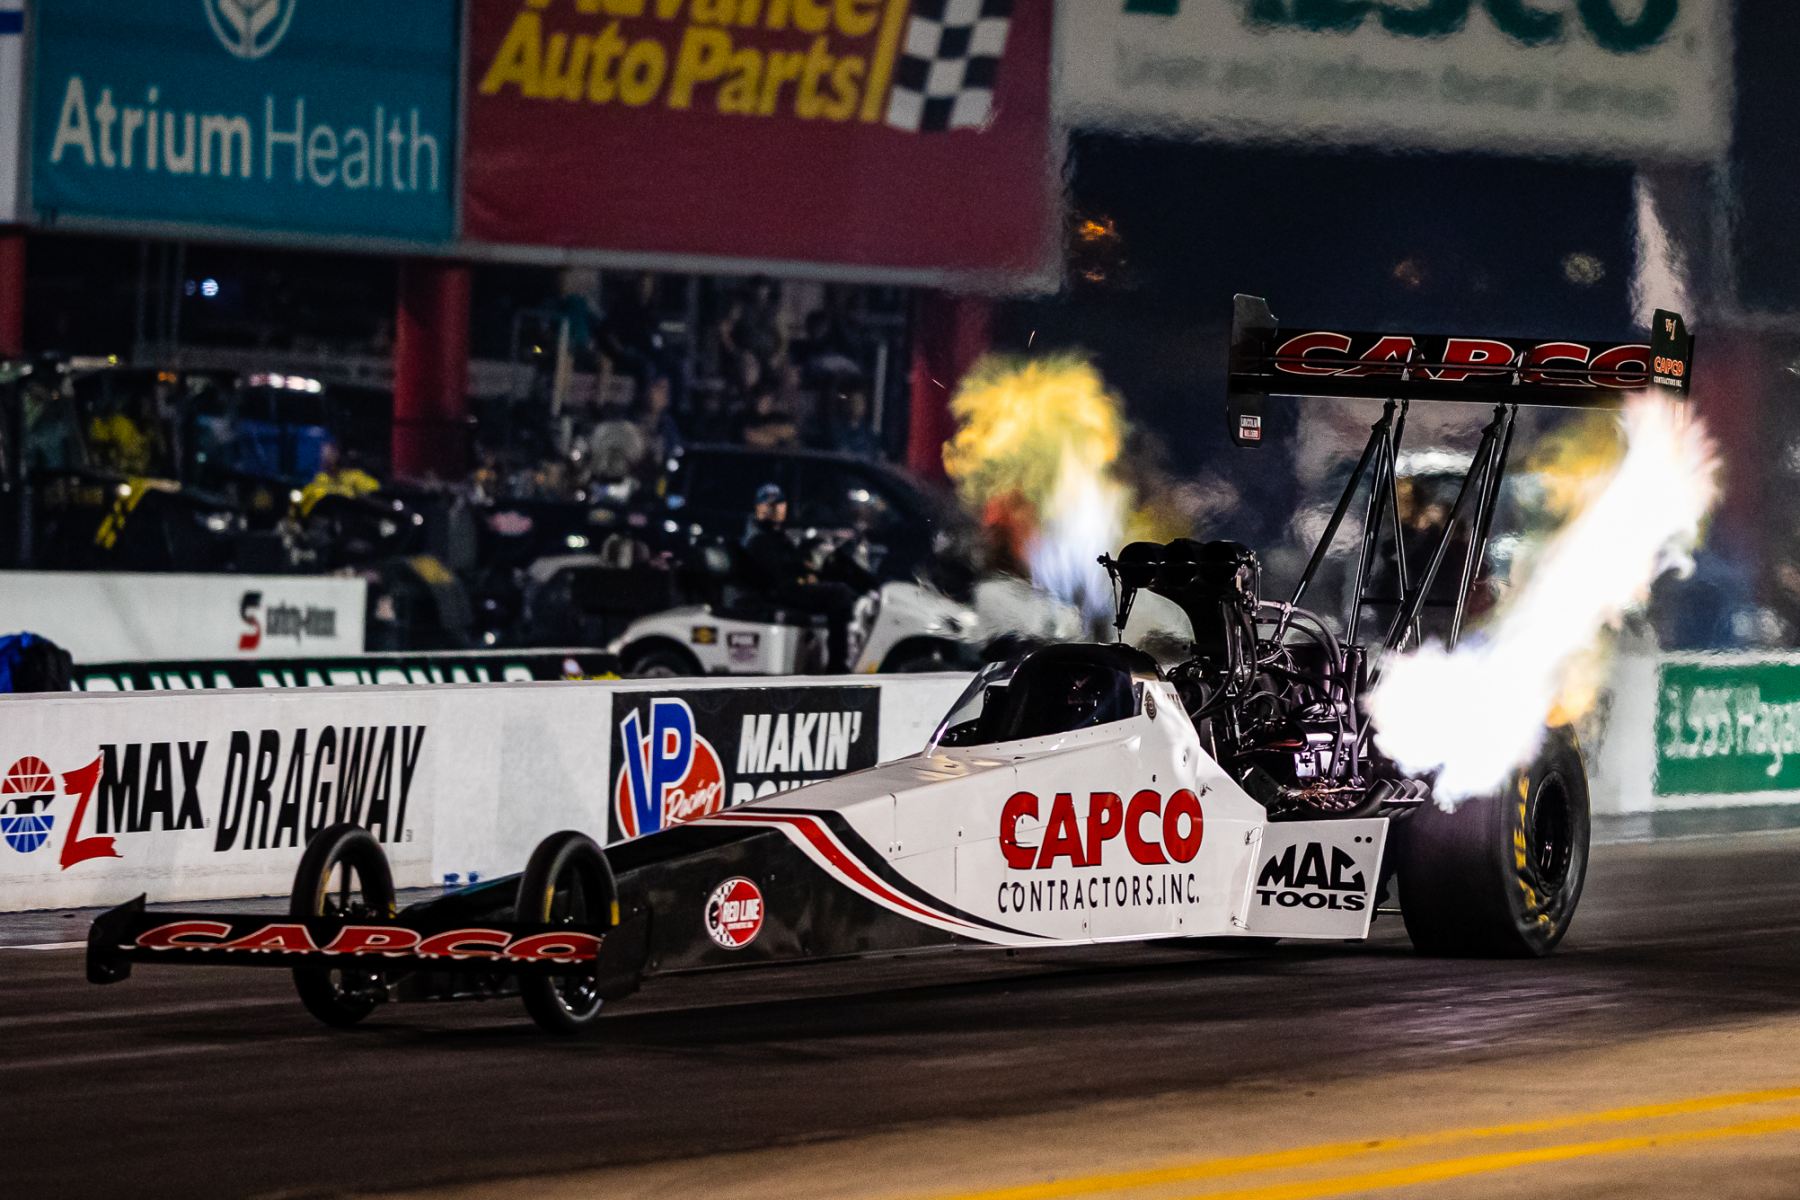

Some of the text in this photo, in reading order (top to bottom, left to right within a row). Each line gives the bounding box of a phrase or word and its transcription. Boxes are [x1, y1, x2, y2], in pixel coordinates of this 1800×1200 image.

[479, 11, 864, 121] Auto Parts
[50, 75, 440, 192] Atrium Health
[1275, 331, 1651, 388] CAPCO
[1654, 356, 1684, 377] CAPCO
[620, 698, 696, 835] VP
[737, 711, 862, 774] MAKIN'
[214, 725, 426, 852] DRAGWAY
[666, 780, 723, 827] Racing
[1000, 788, 1204, 870] CAPCO
[1257, 842, 1366, 892] MAC
[723, 900, 740, 922] RED
[1256, 889, 1366, 911] TOOLS
[136, 920, 602, 963] CAPCO
